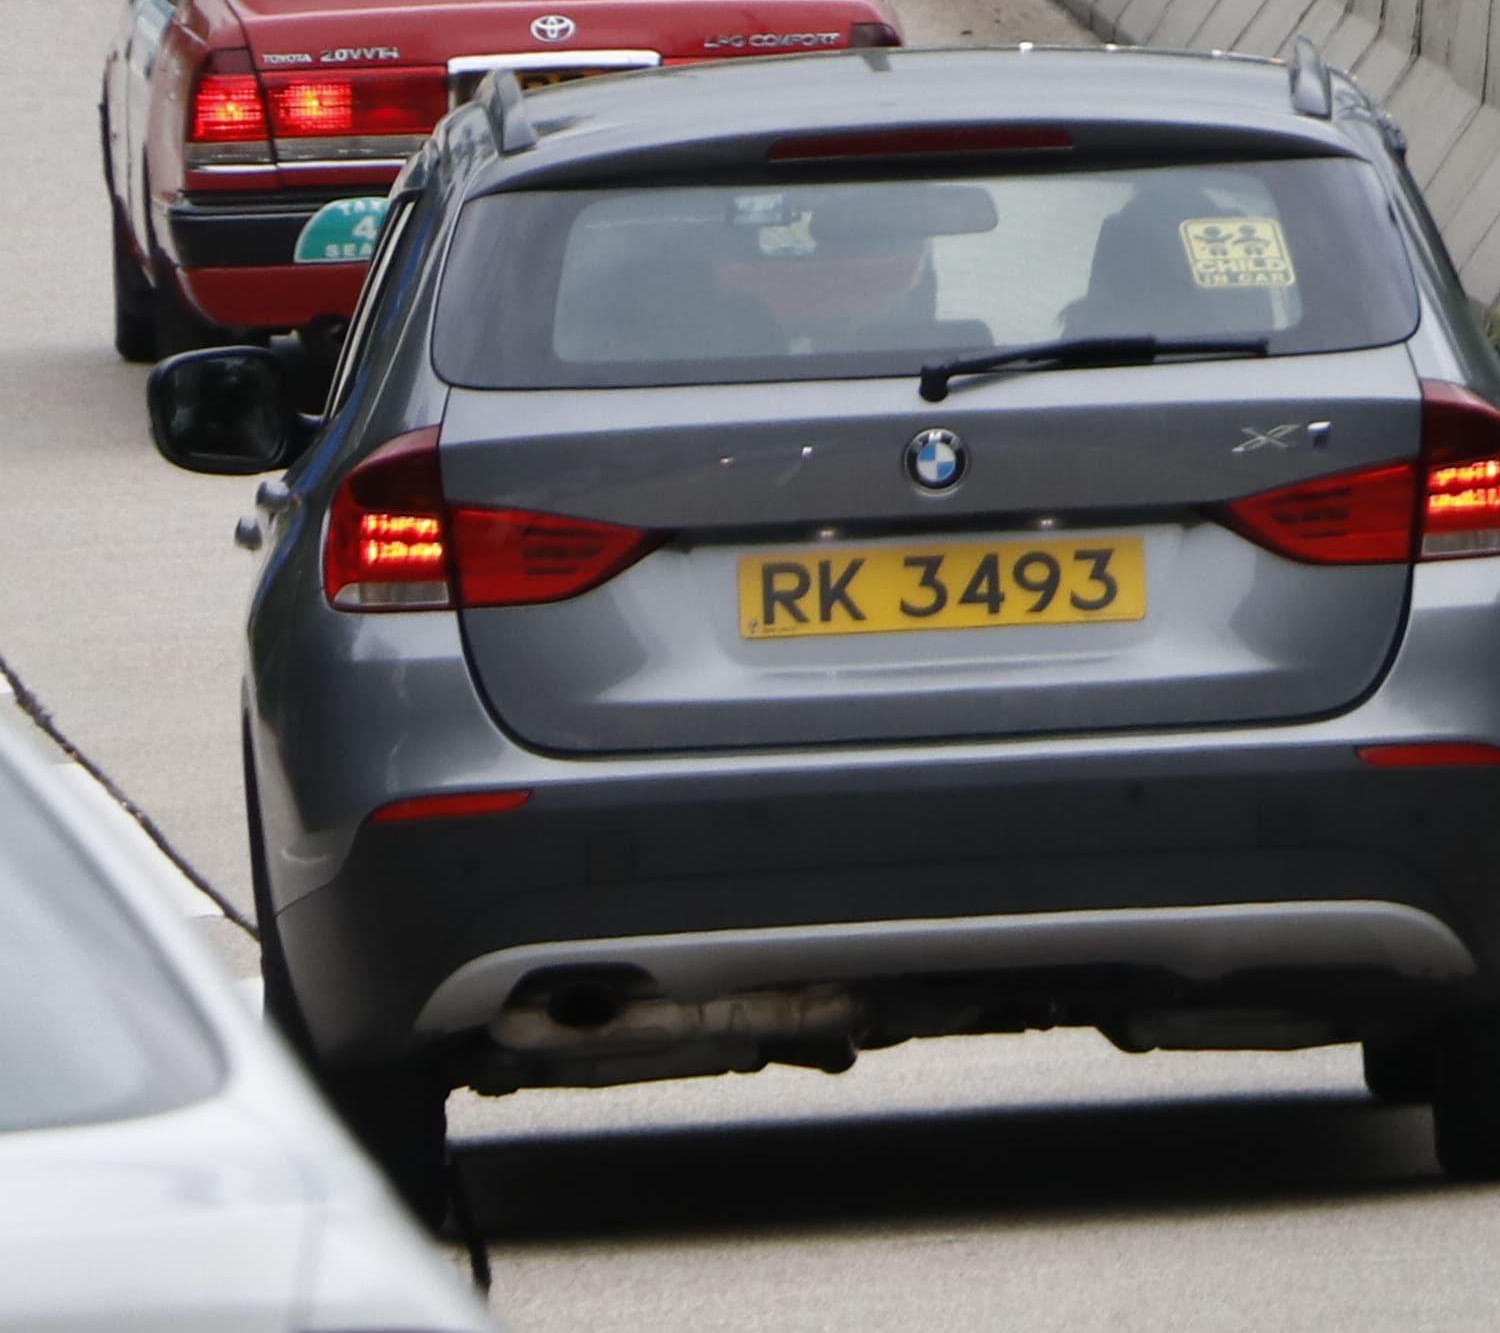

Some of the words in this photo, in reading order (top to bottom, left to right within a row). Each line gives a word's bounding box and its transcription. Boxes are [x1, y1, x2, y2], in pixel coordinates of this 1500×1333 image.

[337, 200, 388, 216] TAX
[351, 214, 379, 242] 4
[324, 243, 374, 259] SEA
[1195, 258, 1288, 274] CHILD
[762, 558, 867, 626] RK
[900, 548, 1119, 618] 3493
